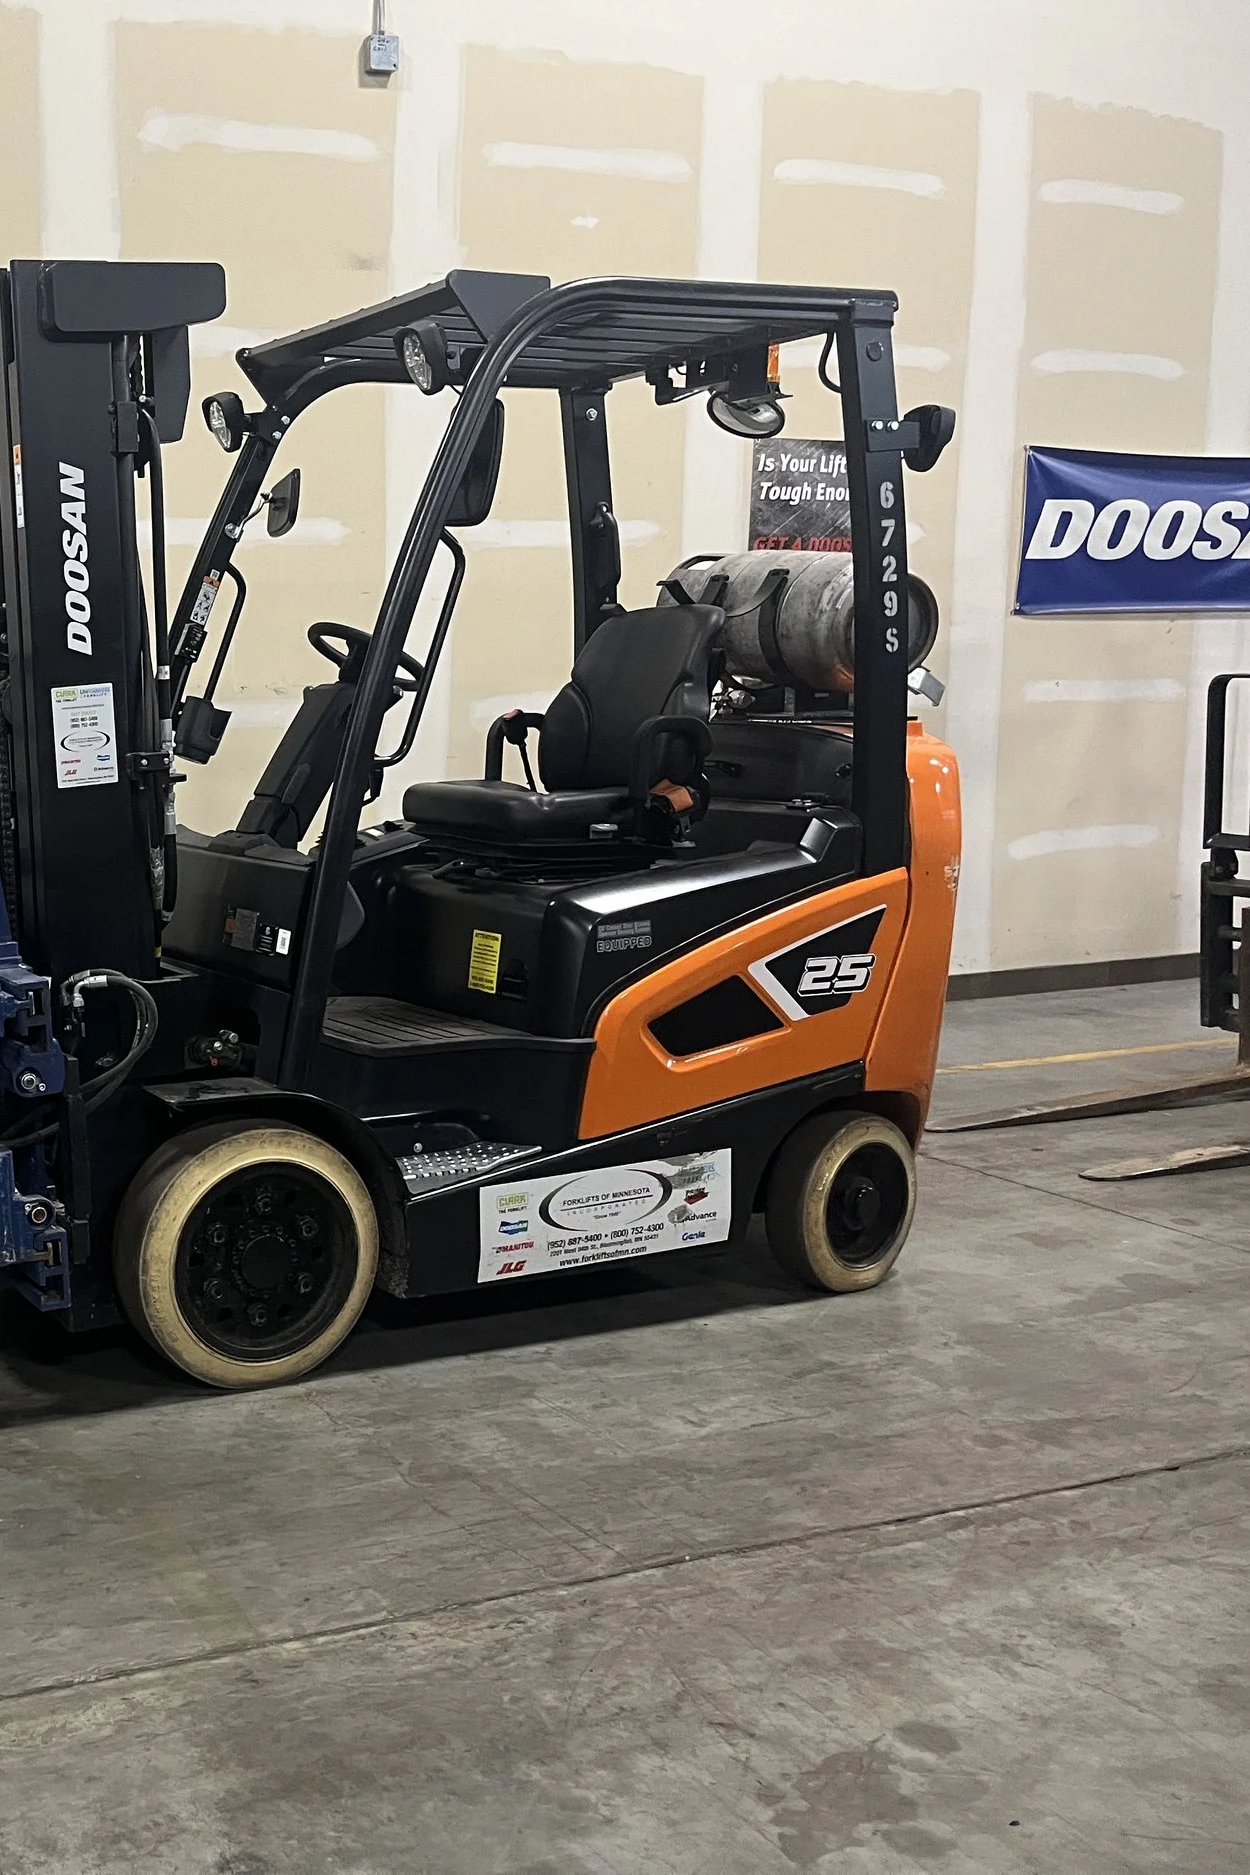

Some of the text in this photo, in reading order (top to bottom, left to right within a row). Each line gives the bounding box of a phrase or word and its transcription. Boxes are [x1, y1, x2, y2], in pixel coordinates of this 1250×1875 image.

[757, 453, 847, 479] Is Your Lift
[759, 481, 812, 506] Tough
[1025, 498, 1250, 561] DOOS
[753, 536, 790, 551] GET
[790, 536, 803, 551] A
[58, 461, 93, 656] DOOSAN
[596, 935, 653, 953] EQUIPPED
[797, 953, 876, 997] 25
[499, 1194, 527, 1208] CLARK
[562, 1187, 651, 1207] FORKLIFTS OF MINNESOTA
[566, 1198, 646, 1217] INCORPORATED
[685, 1211, 717, 1222] Advance
[547, 1222, 665, 1251] (952) 887-5400 (800) 752-4300
[681, 1230, 706, 1242] Genie
[559, 1245, 647, 1267] www.forkliftsofmn.com
[496, 1260, 527, 1276] JLG
